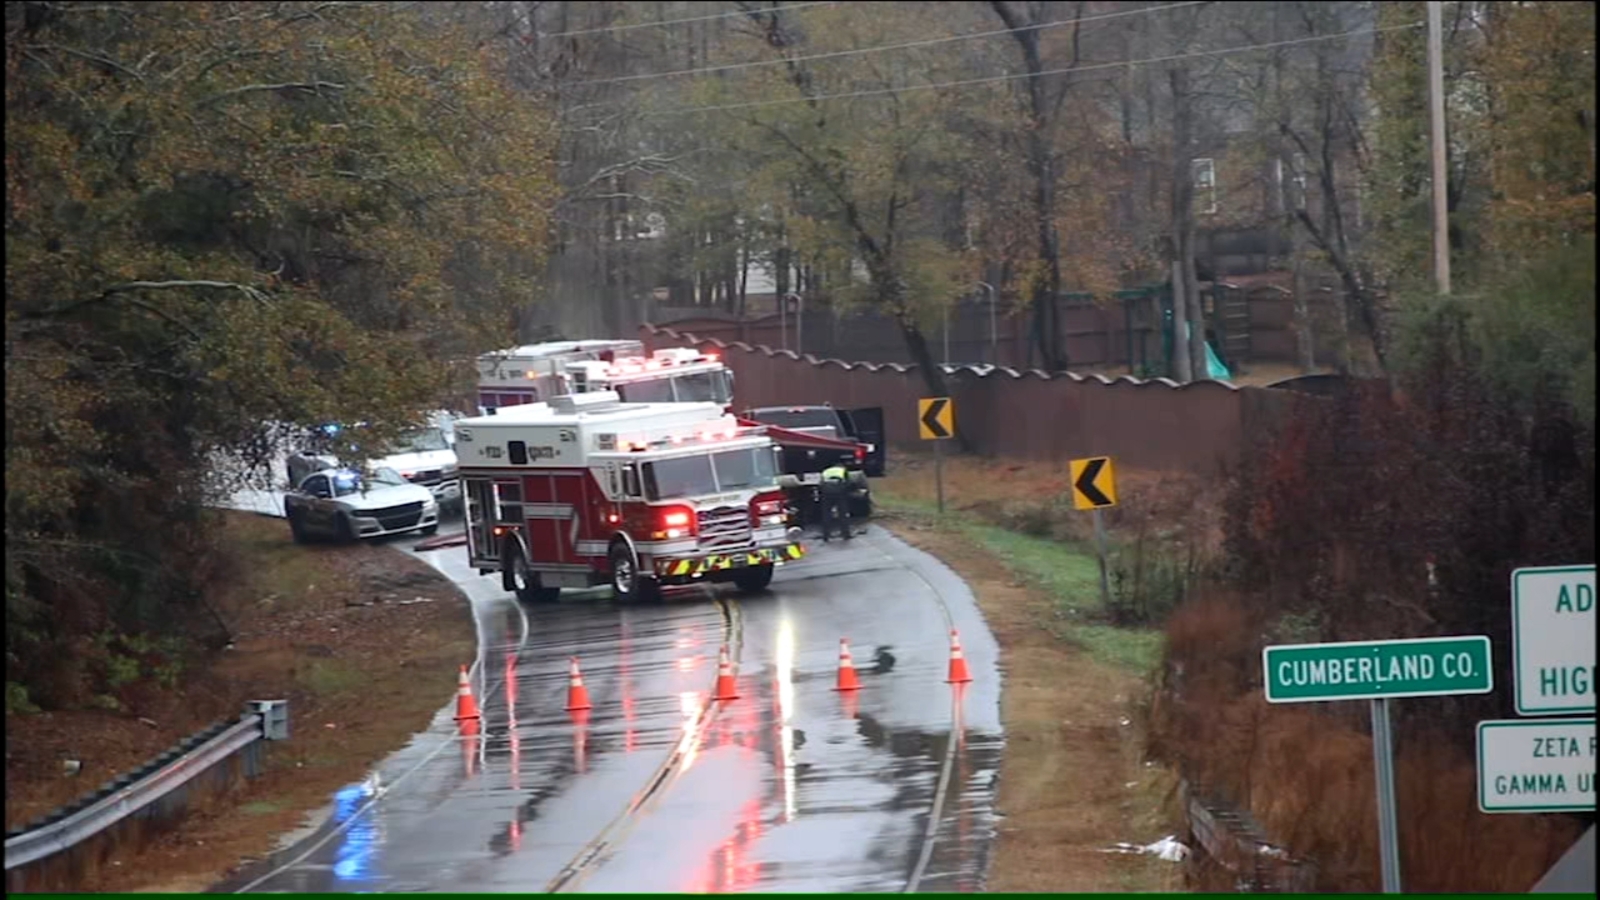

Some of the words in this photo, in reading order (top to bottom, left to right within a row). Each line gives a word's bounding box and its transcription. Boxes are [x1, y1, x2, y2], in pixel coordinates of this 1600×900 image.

[1279, 654, 1434, 686] CUMBERLAND
[1442, 652, 1479, 678] CO.
[1540, 666, 1596, 696] HIG
[1533, 737, 1580, 757] ZETA
[1495, 774, 1566, 795] GAMMA
[1577, 773, 1596, 793] U
